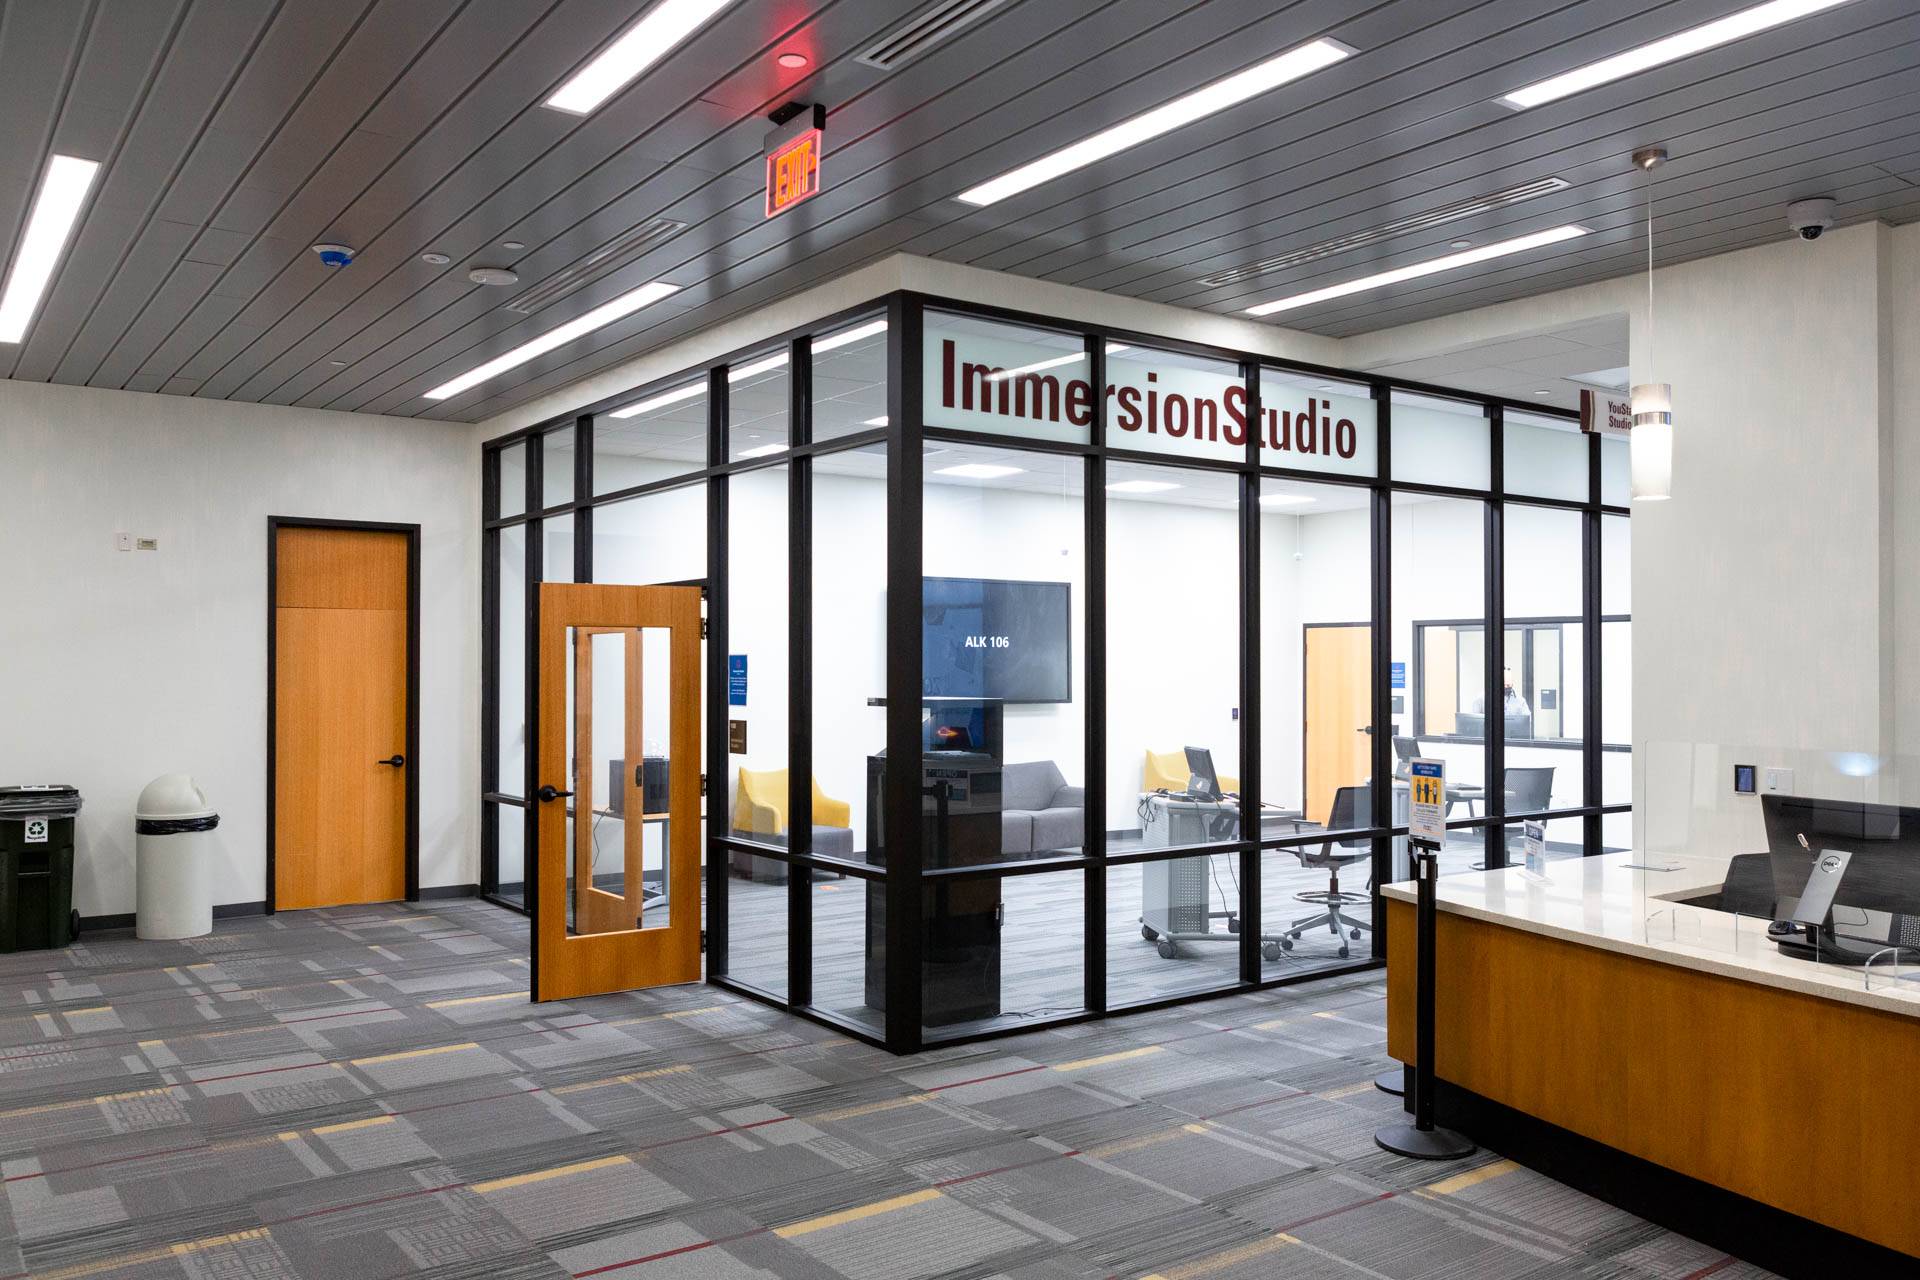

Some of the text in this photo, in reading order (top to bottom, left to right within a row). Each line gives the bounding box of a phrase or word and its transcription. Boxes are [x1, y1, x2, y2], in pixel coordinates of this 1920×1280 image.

[775, 140, 812, 209] EXIT
[1608, 416, 1631, 430] Studio
[965, 636, 1009, 648] ALK 106
